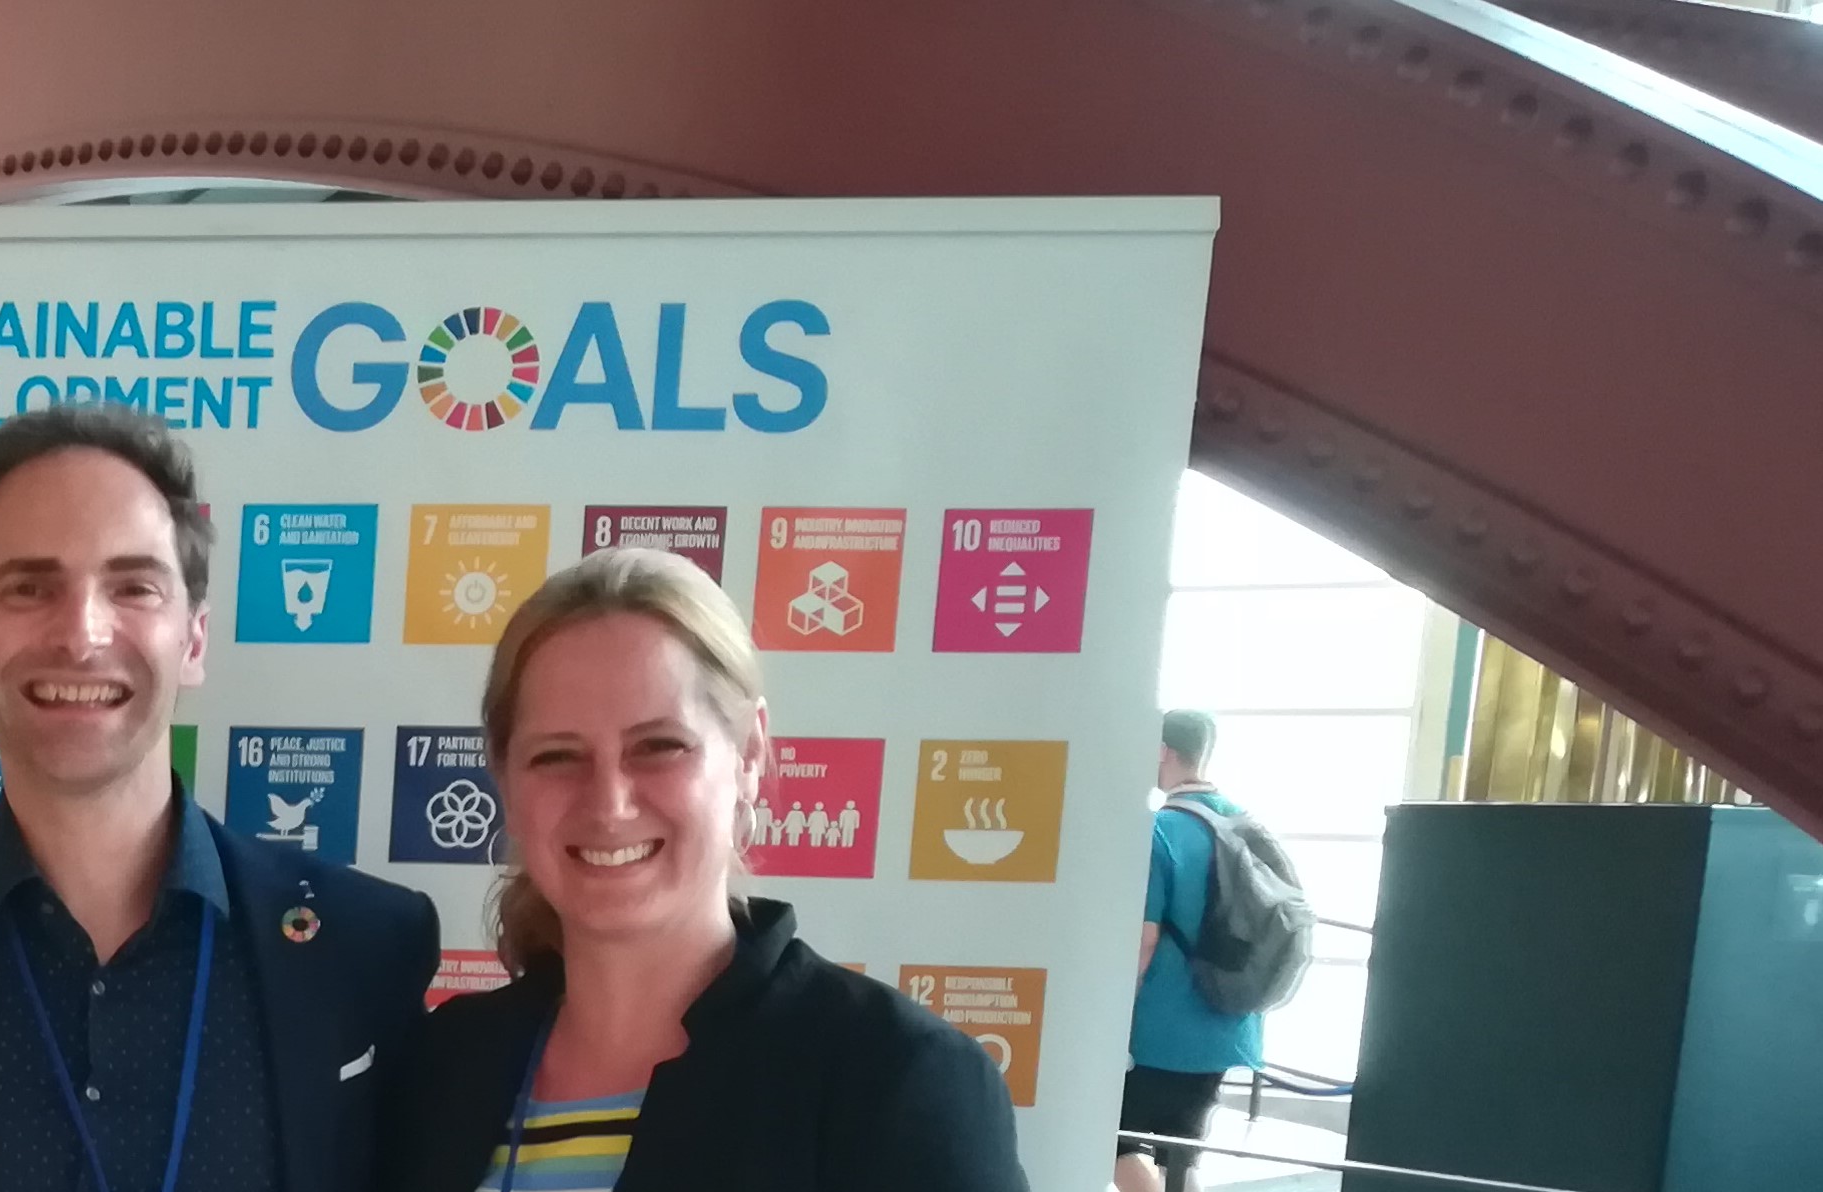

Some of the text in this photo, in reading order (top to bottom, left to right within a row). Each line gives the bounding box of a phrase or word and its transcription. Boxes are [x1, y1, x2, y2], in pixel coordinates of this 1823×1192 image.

[290, 299, 831, 433] GOALS
[254, 514, 270, 545] 6
[424, 515, 438, 545] 7
[595, 516, 612, 547] 8
[621, 516, 717, 531] DECENT WORK AND
[770, 518, 787, 549] 9
[952, 519, 982, 551] 10
[674, 533, 720, 548] GROWTH
[987, 536, 1061, 552] INEQUALITIES
[238, 736, 264, 767] 16
[305, 737, 347, 752] JUSTICE
[407, 736, 431, 767] 17
[437, 752, 457, 768] FOR
[457, 752, 478, 768] THE
[931, 750, 947, 781] 2
[267, 769, 335, 784] INSTITUTIONS
[909, 975, 936, 1005] 12
